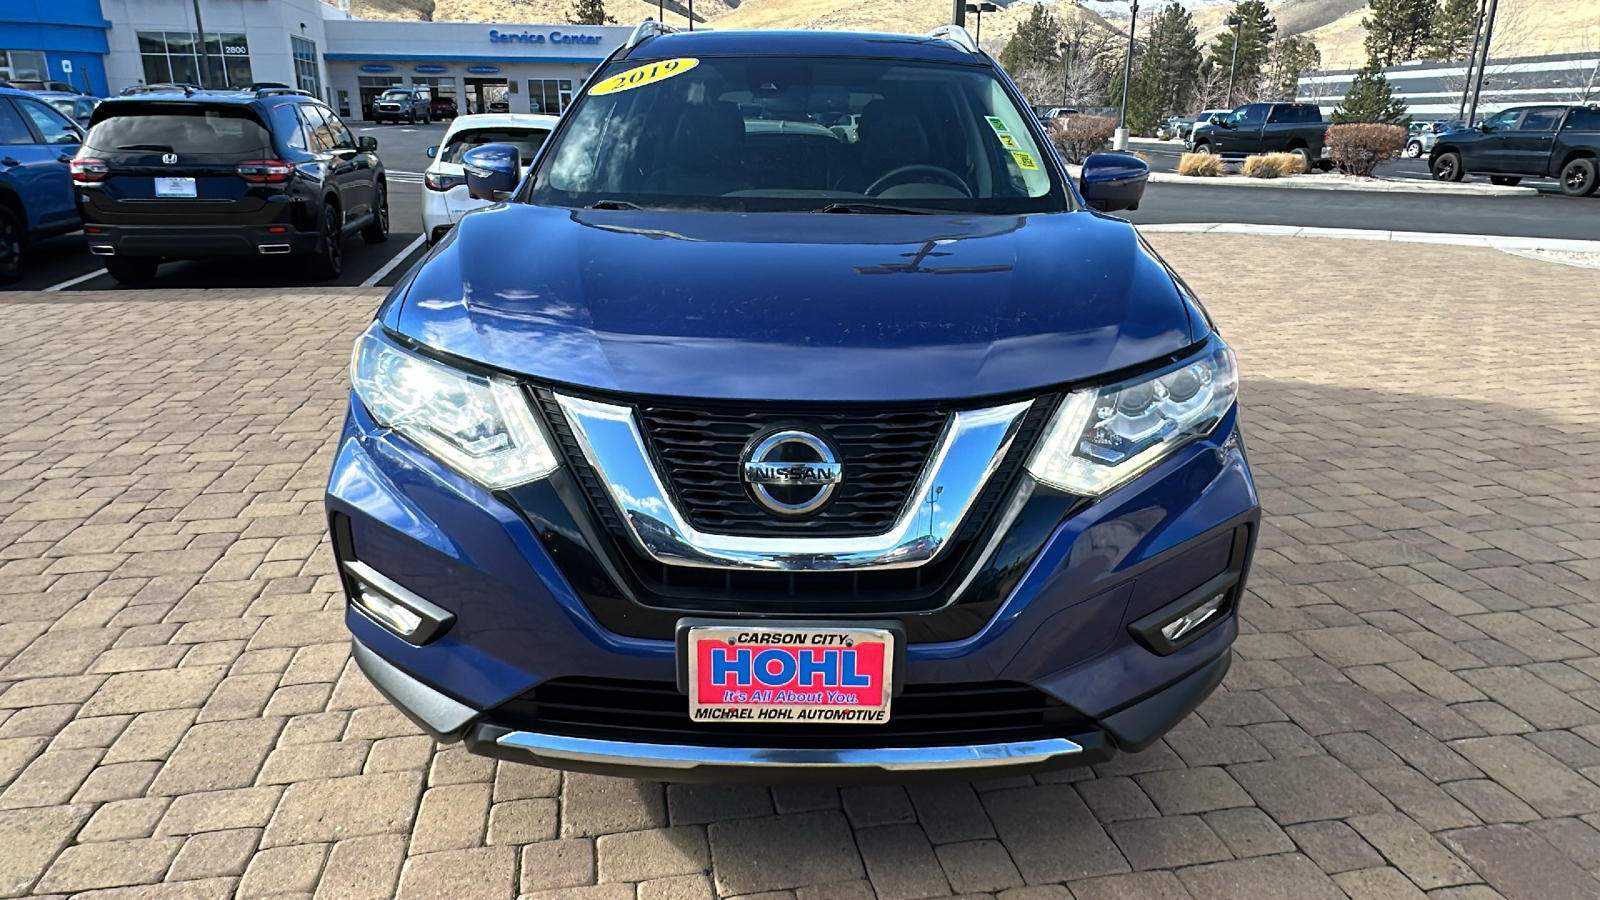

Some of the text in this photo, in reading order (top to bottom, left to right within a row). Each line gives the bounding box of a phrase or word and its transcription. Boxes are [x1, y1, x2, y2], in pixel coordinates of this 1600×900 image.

[489, 29, 603, 44] Service Center
[225, 46, 246, 54] 2800
[611, 61, 679, 91] 2019
[755, 467, 831, 480] NISSAN
[737, 632, 849, 645] CARSON CITY
[711, 648, 871, 687] HOHL
[724, 690, 859, 703] It's All About You.
[695, 708, 886, 721] MICHAEL HOHL AUTOMOTIVE
